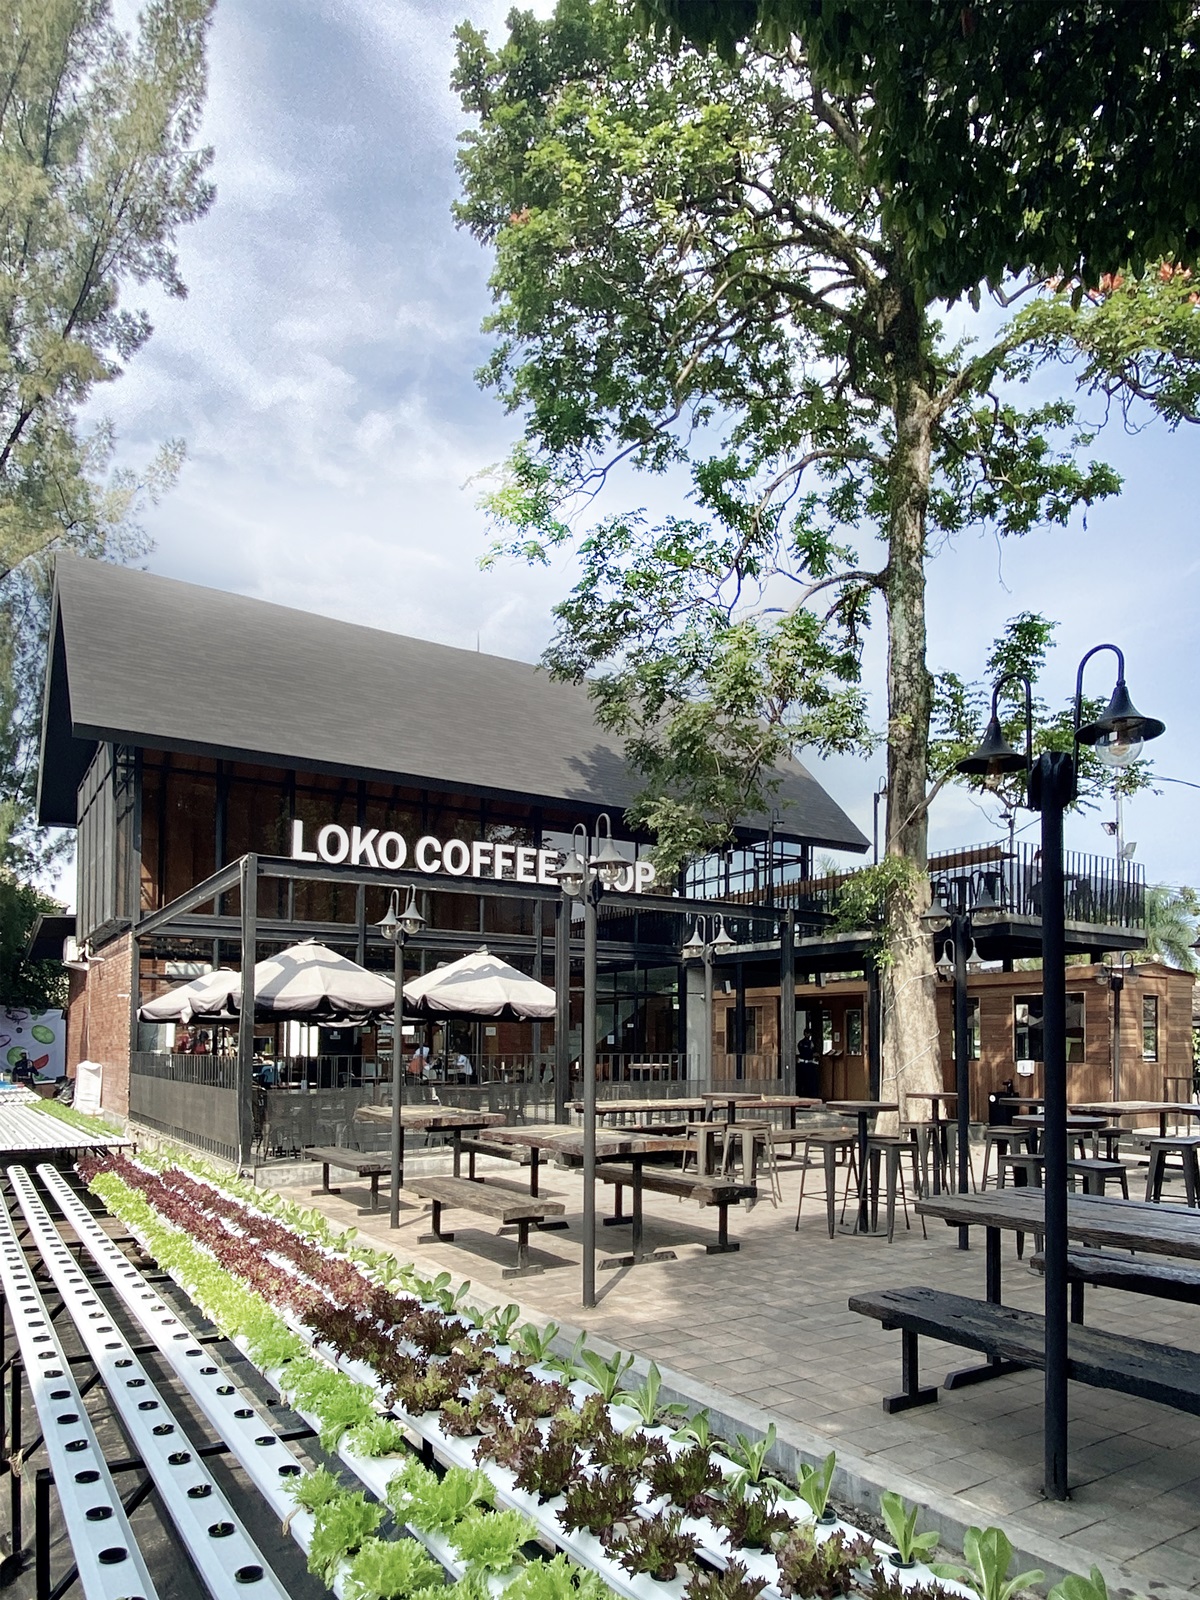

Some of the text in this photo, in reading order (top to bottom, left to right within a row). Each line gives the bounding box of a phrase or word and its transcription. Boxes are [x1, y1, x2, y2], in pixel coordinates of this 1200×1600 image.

[292, 819, 656, 893] LOKO COFFEE OP
